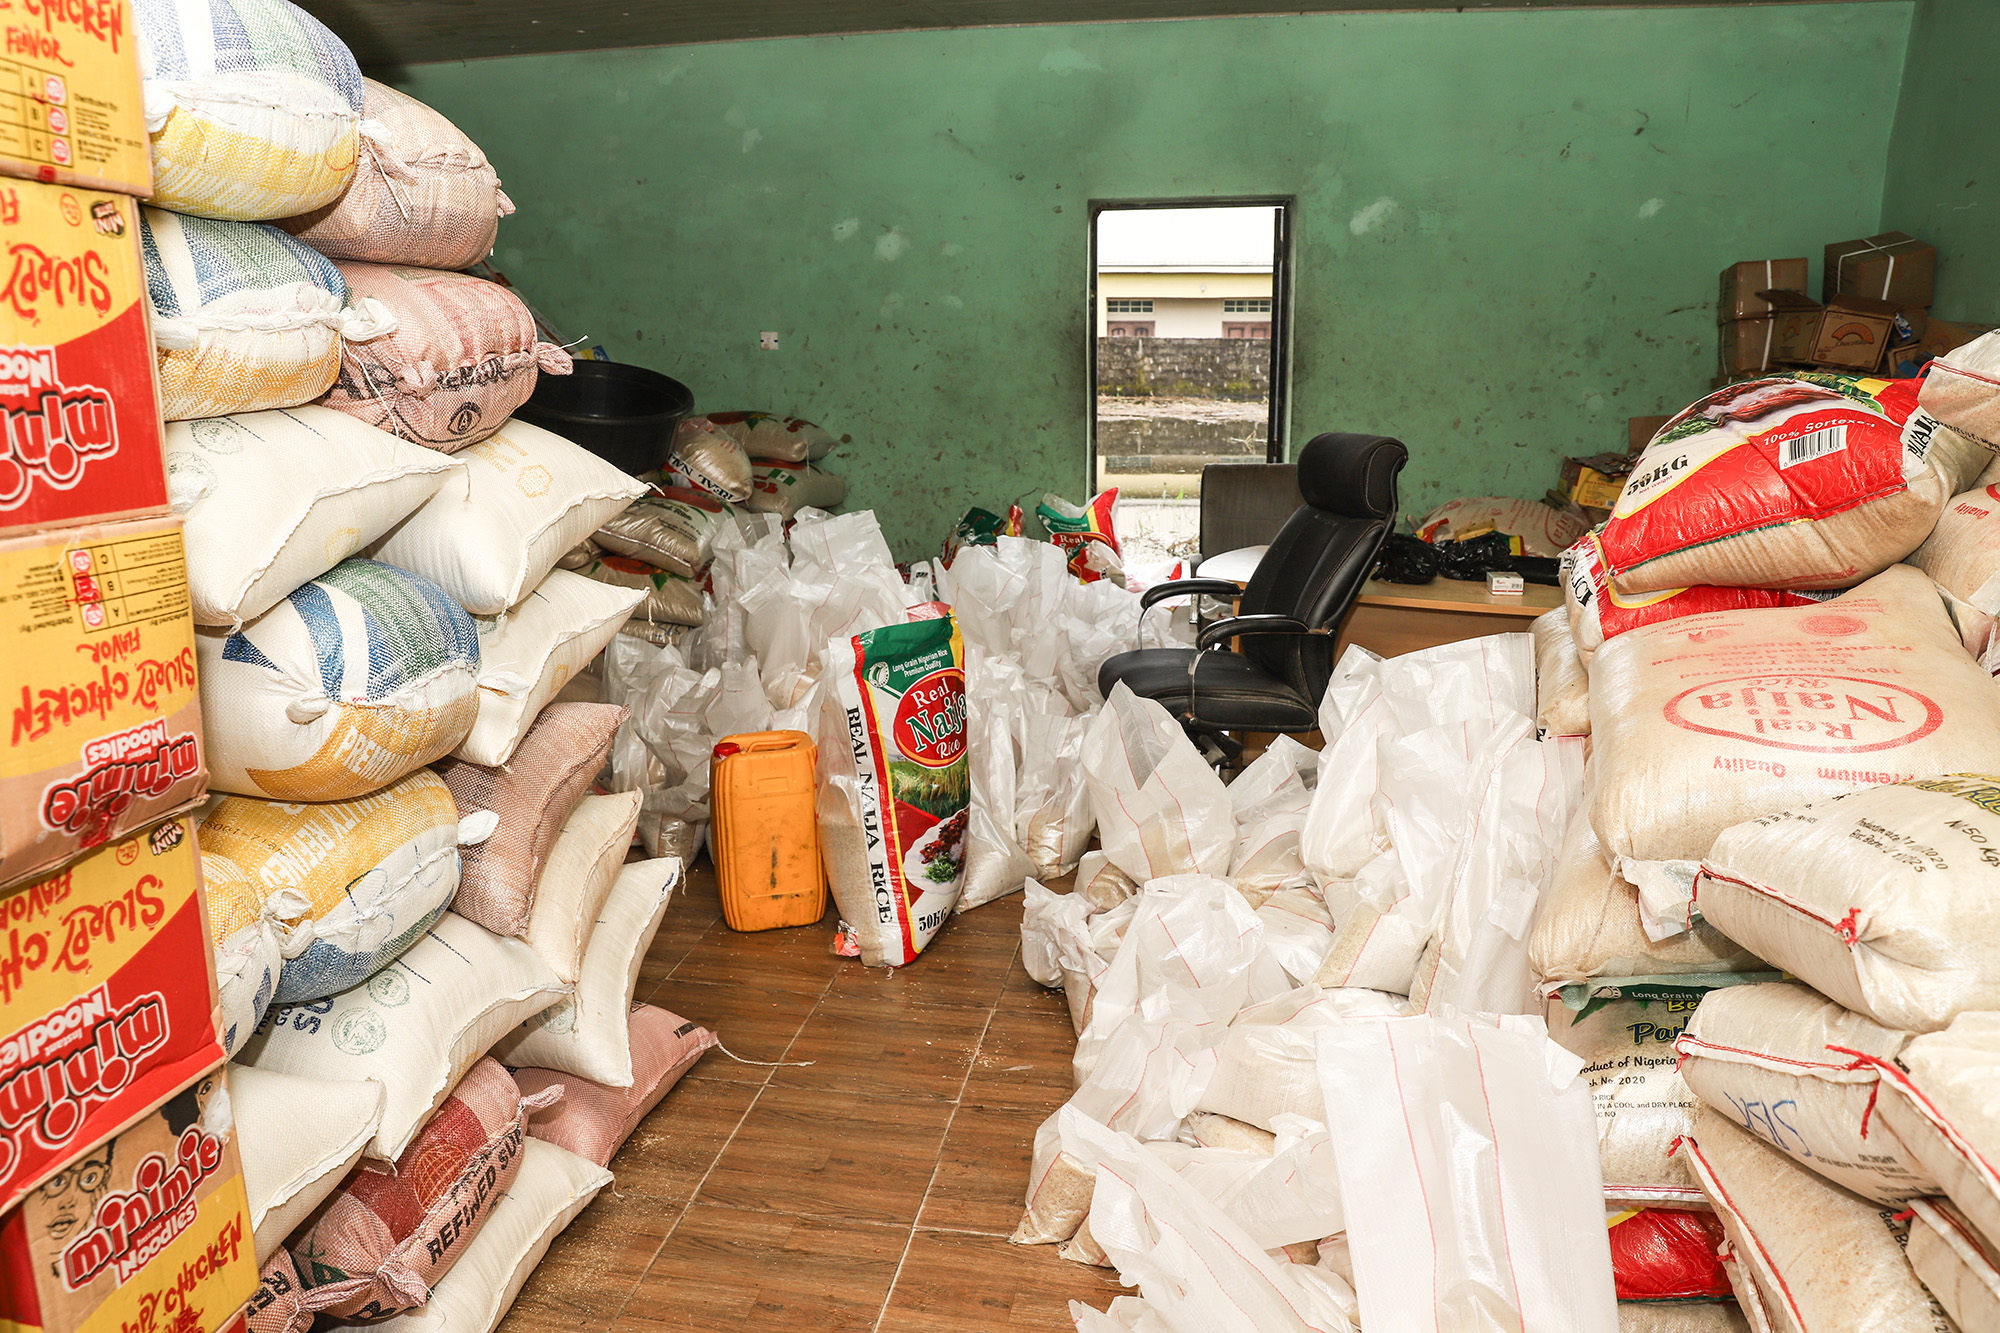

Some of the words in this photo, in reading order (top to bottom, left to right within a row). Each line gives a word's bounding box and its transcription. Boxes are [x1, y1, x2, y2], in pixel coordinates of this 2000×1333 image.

[1763, 428, 1800, 446] 100%
[698, 473, 735, 501] REAL
[1954, 502, 1990, 520] Quality
[1059, 534, 1085, 544] Real
[75, 626, 141, 664] FLAVOR
[892, 663, 905, 674] Long
[903, 658, 919, 670] Grain
[918, 651, 938, 665] Nigerian
[937, 648, 949, 657] Rice
[903, 664, 925, 678] Premium
[924, 659, 942, 671] Quality
[910, 676, 951, 710] Real
[1748, 677, 1830, 690] Rice
[11, 664, 129, 747] CHICKEN
[1696, 685, 1906, 724] Naija
[845, 705, 869, 765] REAL
[905, 691, 968, 753] Naija
[1754, 718, 1857, 741] Real
[87, 722, 165, 764] Noodles
[936, 738, 961, 759] Rice
[1713, 755, 1787, 779] Quality
[858, 771, 881, 852] NAIJA
[869, 861, 893, 924] RICE
[918, 906, 948, 932] 50KG
[1632, 991, 1657, 1000] Long
[1660, 991, 1689, 1000] Grain
[0, 991, 106, 1067] Noodle
[1579, 1059, 1614, 1075] roduct
[1617, 1055, 1630, 1067] of
[1633, 1055, 1678, 1070] Nigeria
[1618, 1075, 1646, 1086] 2020
[66, 1127, 222, 1284] minimie
[119, 1202, 197, 1280] Noodles
[164, 1210, 242, 1317] CHICKEN
